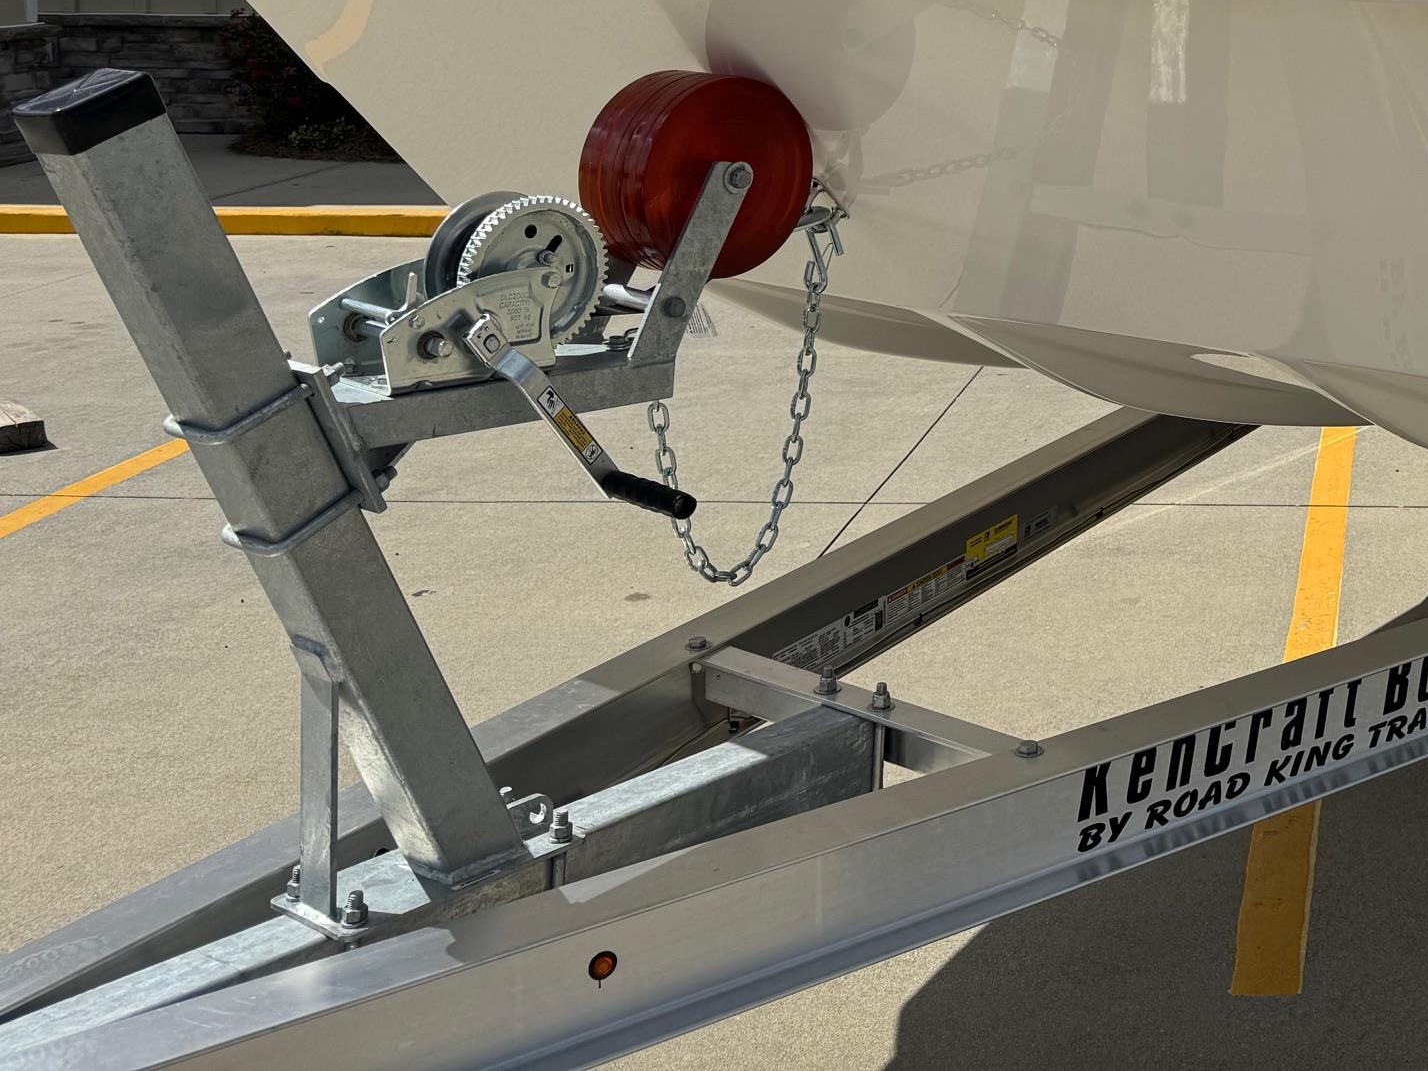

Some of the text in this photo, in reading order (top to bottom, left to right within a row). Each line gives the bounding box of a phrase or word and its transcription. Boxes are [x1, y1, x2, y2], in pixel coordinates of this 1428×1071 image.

[1077, 811, 1133, 853] BY
[1144, 772, 1251, 830] ROAD
[1263, 733, 1355, 787] KING
